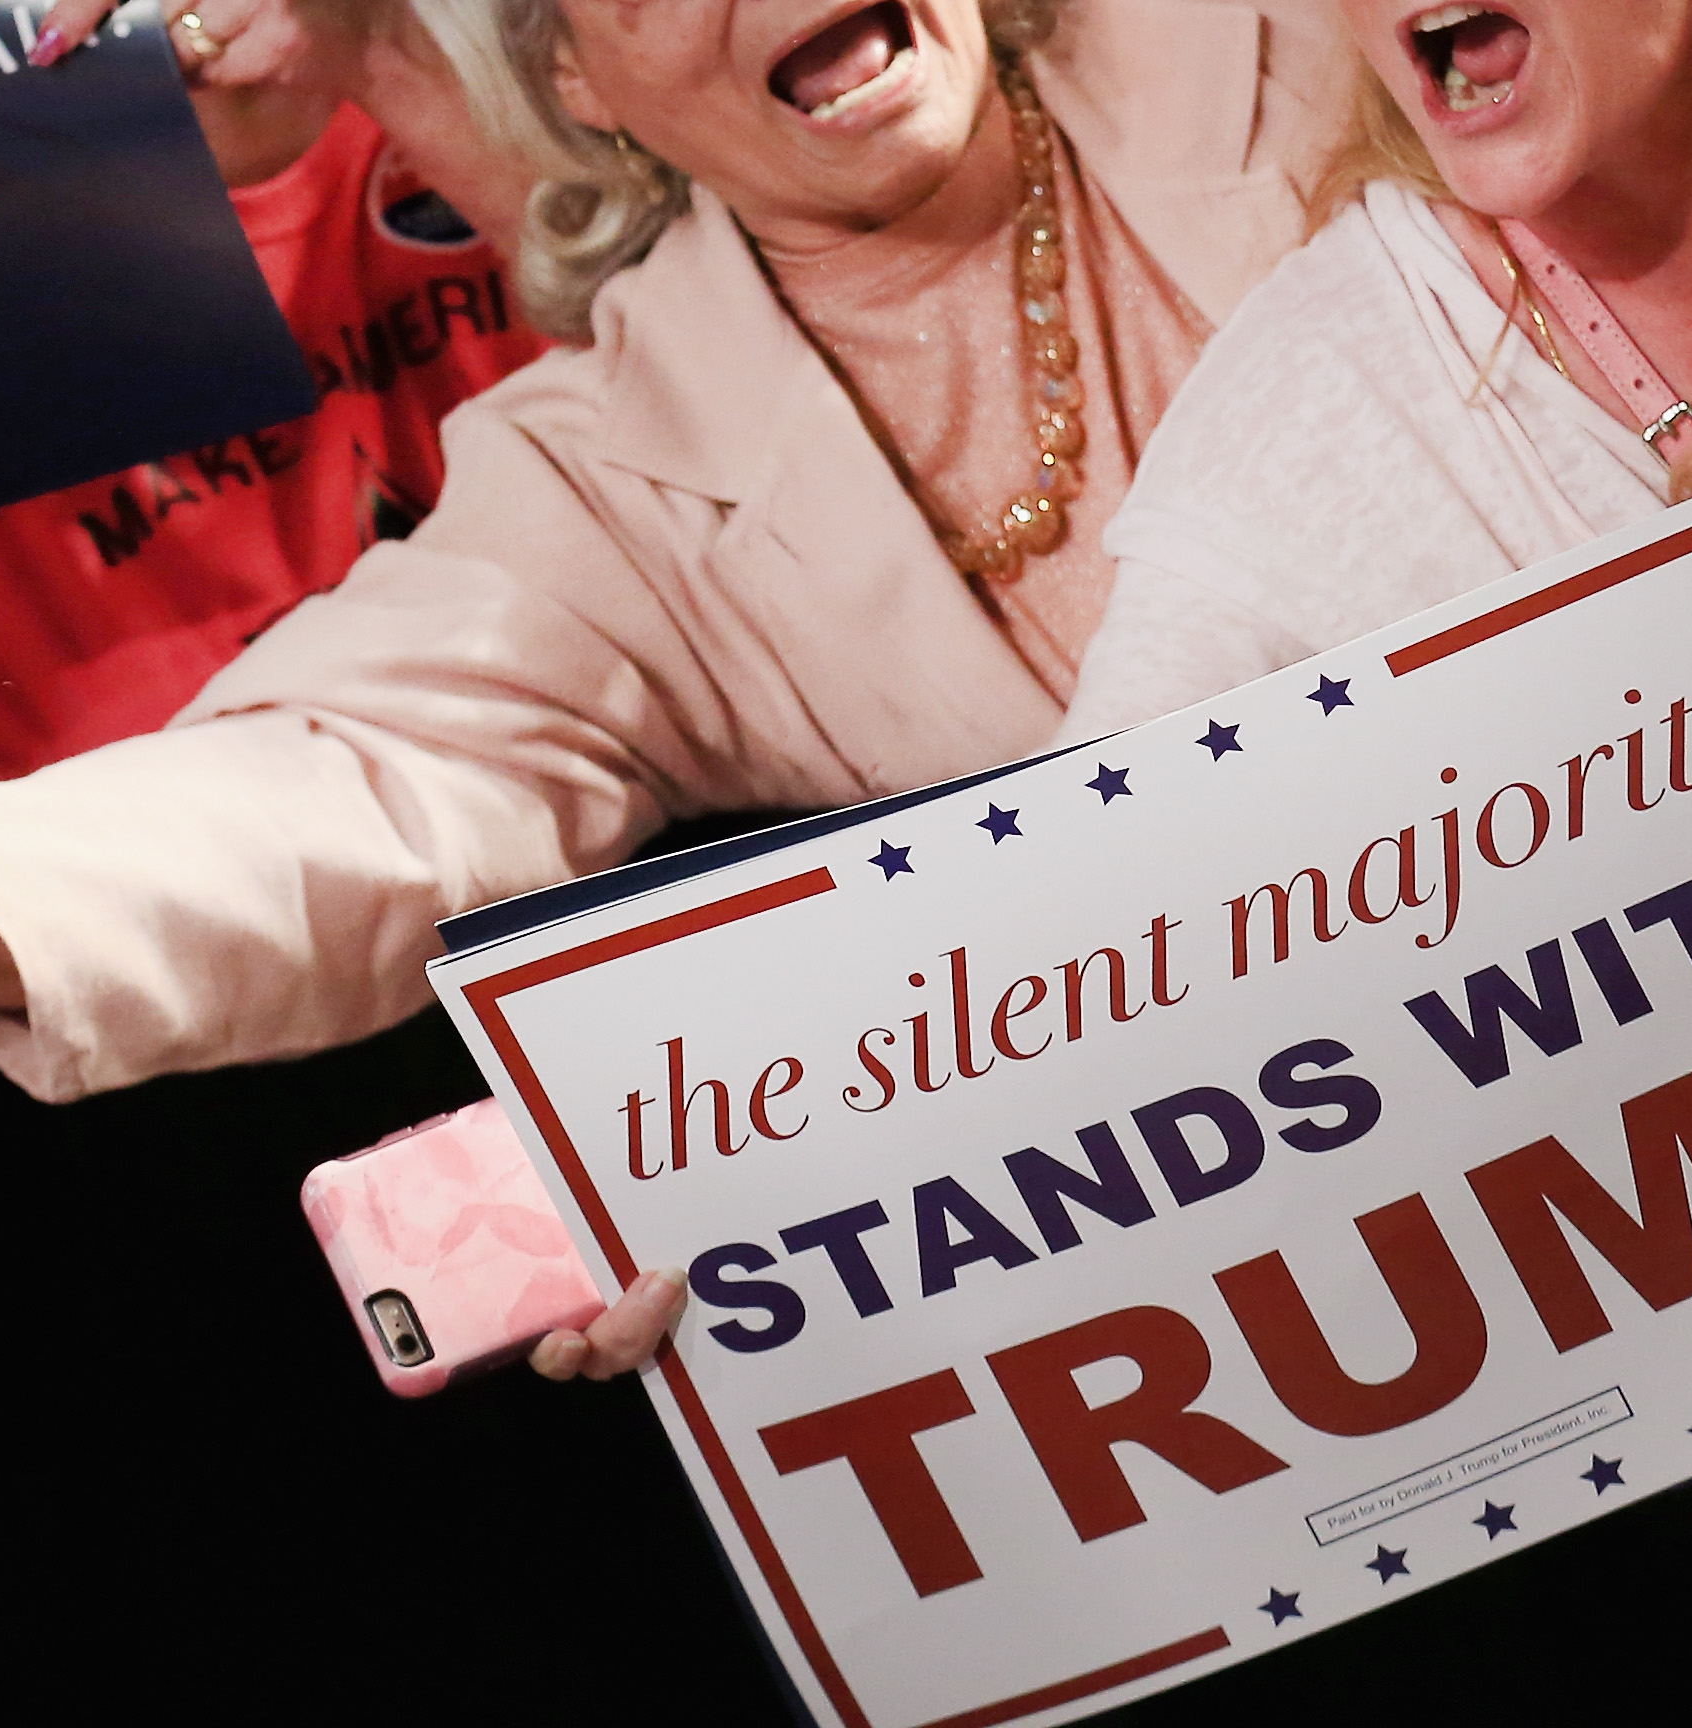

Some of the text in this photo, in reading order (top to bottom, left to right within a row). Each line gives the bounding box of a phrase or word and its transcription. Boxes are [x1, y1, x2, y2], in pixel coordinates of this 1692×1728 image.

[77, 428, 305, 568] MAKE
[616, 1036, 811, 1181] the
[840, 914, 1191, 1113] silent
[688, 1038, 1383, 1355] STANDS
[1326, 1508, 1358, 1530] Paid
[1359, 1502, 1376, 1517] for
[1378, 1493, 1396, 1508] by
[1397, 1475, 1443, 1502] Donald
[1461, 1451, 1501, 1476] Trump
[1501, 1444, 1520, 1460] for
